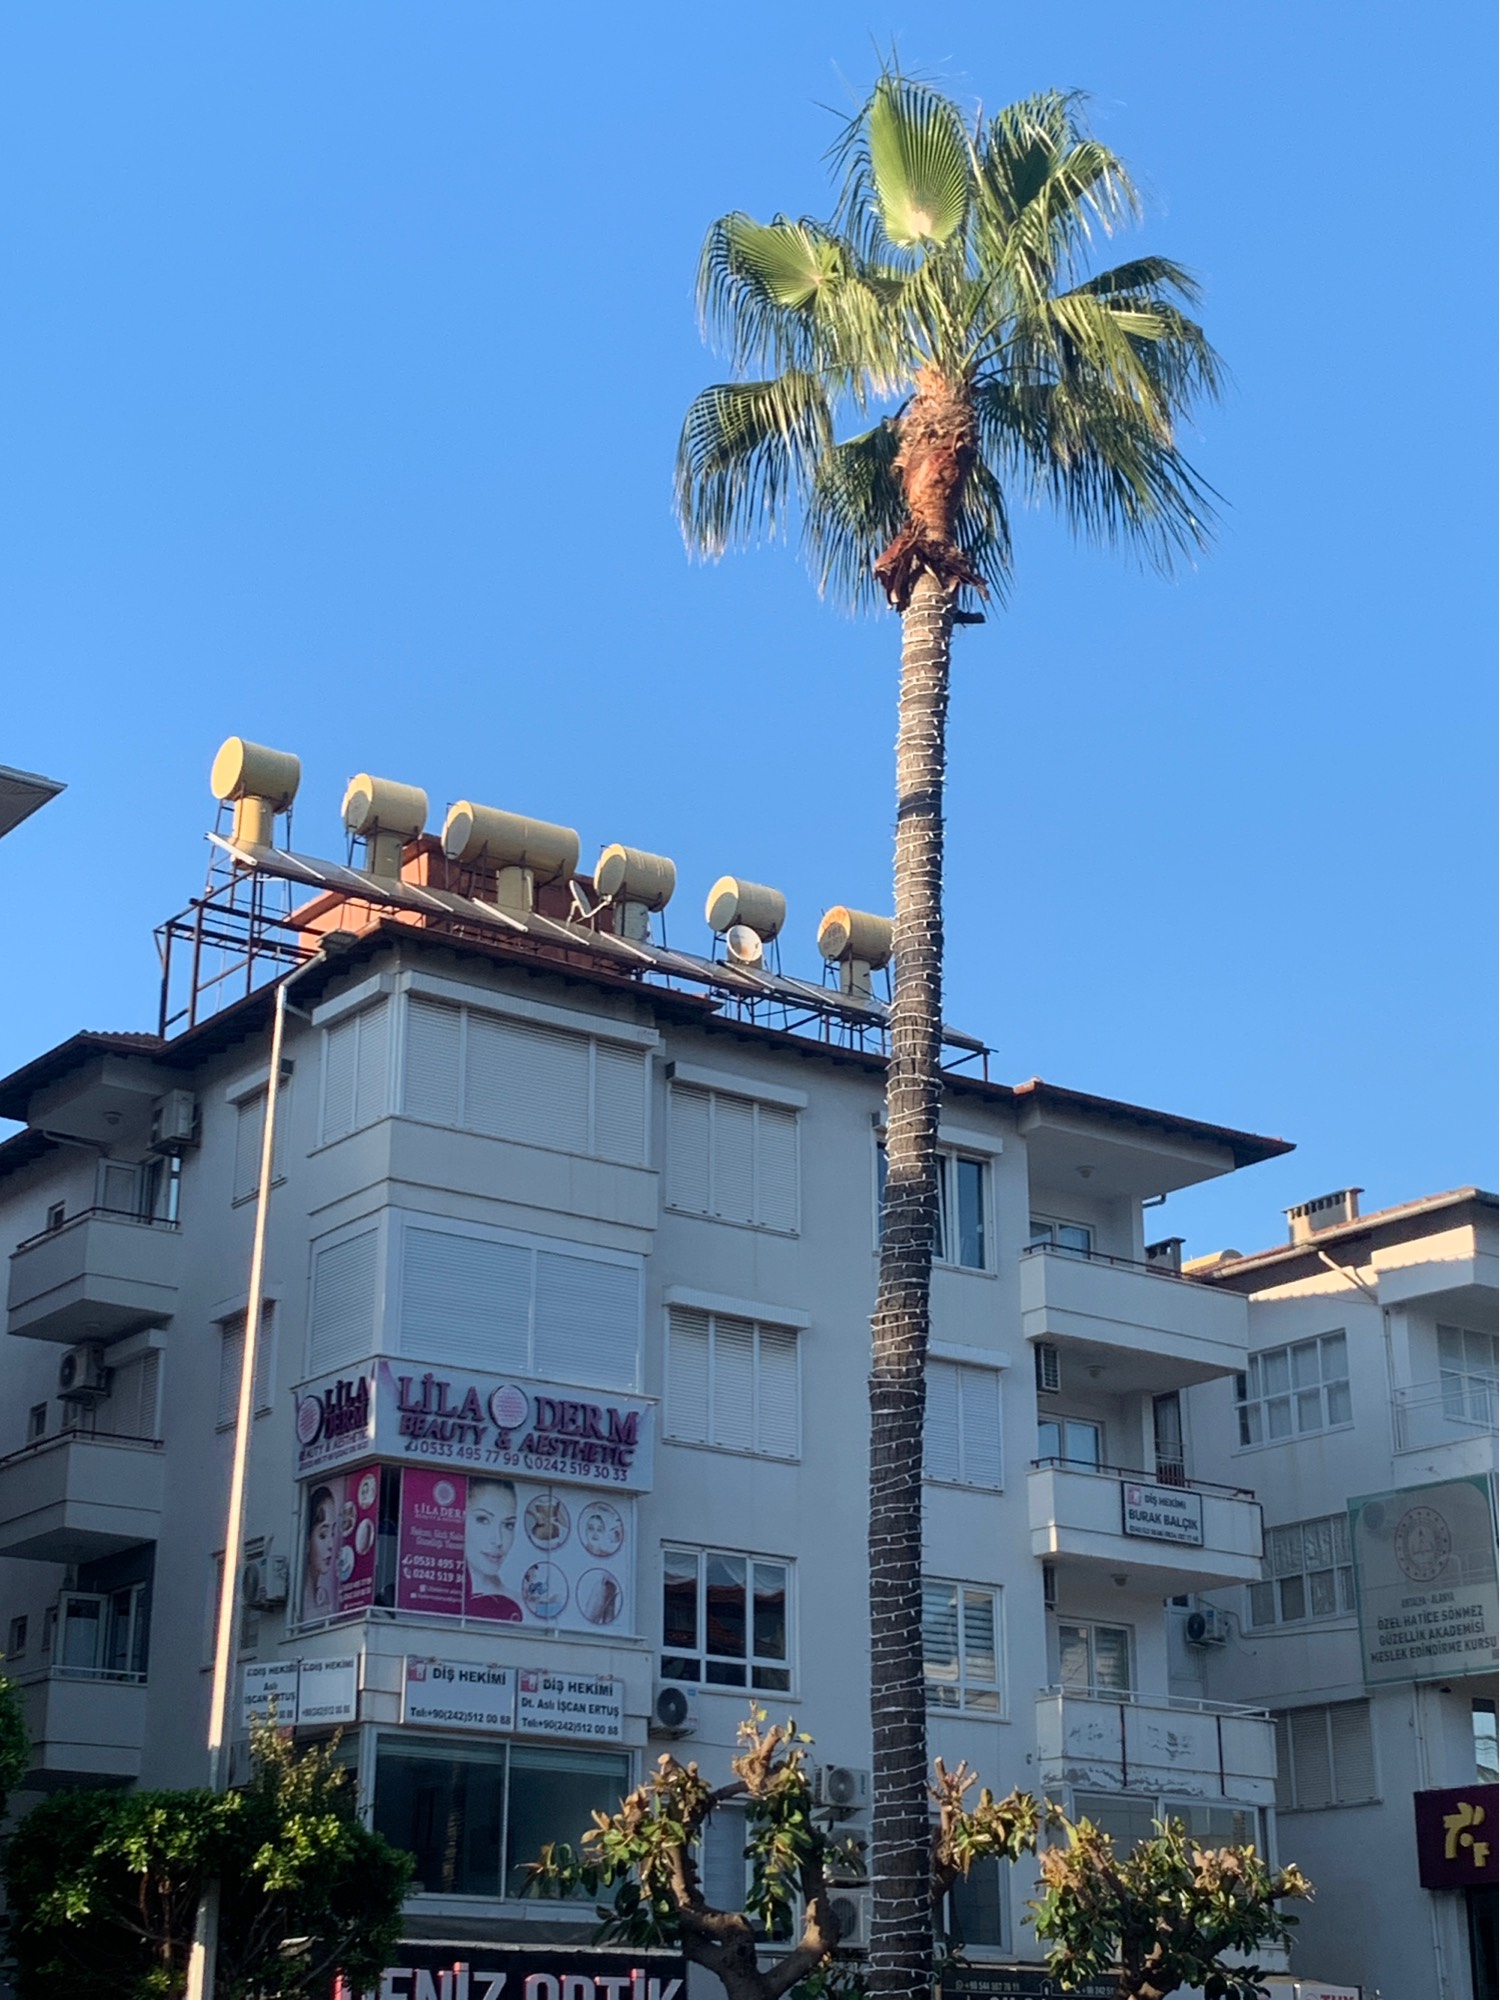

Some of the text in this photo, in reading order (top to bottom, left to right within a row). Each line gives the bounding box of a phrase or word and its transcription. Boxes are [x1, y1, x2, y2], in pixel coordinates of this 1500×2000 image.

[397, 1372, 640, 1445] LİLA DERM
[399, 1414, 636, 1467] BEAUTY & AESTHETIC
[421, 1441, 627, 1482] 0533 495 77 99 0242 519 30 33
[1128, 1509, 1198, 1531] BURAK BALÇIK
[1377, 1605, 1484, 1630] ÖZEL HATİCE SÖNMEZ
[1378, 1618, 1485, 1646] GÜZELLİK AKADEMİSİ
[1370, 1636, 1497, 1663] MESLEK EDİNDİRME KURSU
[432, 1667, 507, 1686] DİŞ HEKİMİ
[543, 1678, 614, 1697] DİŞ HEKİMİ
[486, 1713, 498, 1724] 00
[500, 1714, 511, 1725] 88
[537, 1699, 555, 1710] Aslı
[557, 1699, 586, 1715] İŞCAN
[588, 1703, 620, 1717] ERTUŞ
[594, 1725, 606, 1735] 00
[607, 1726, 619, 1736] 88
